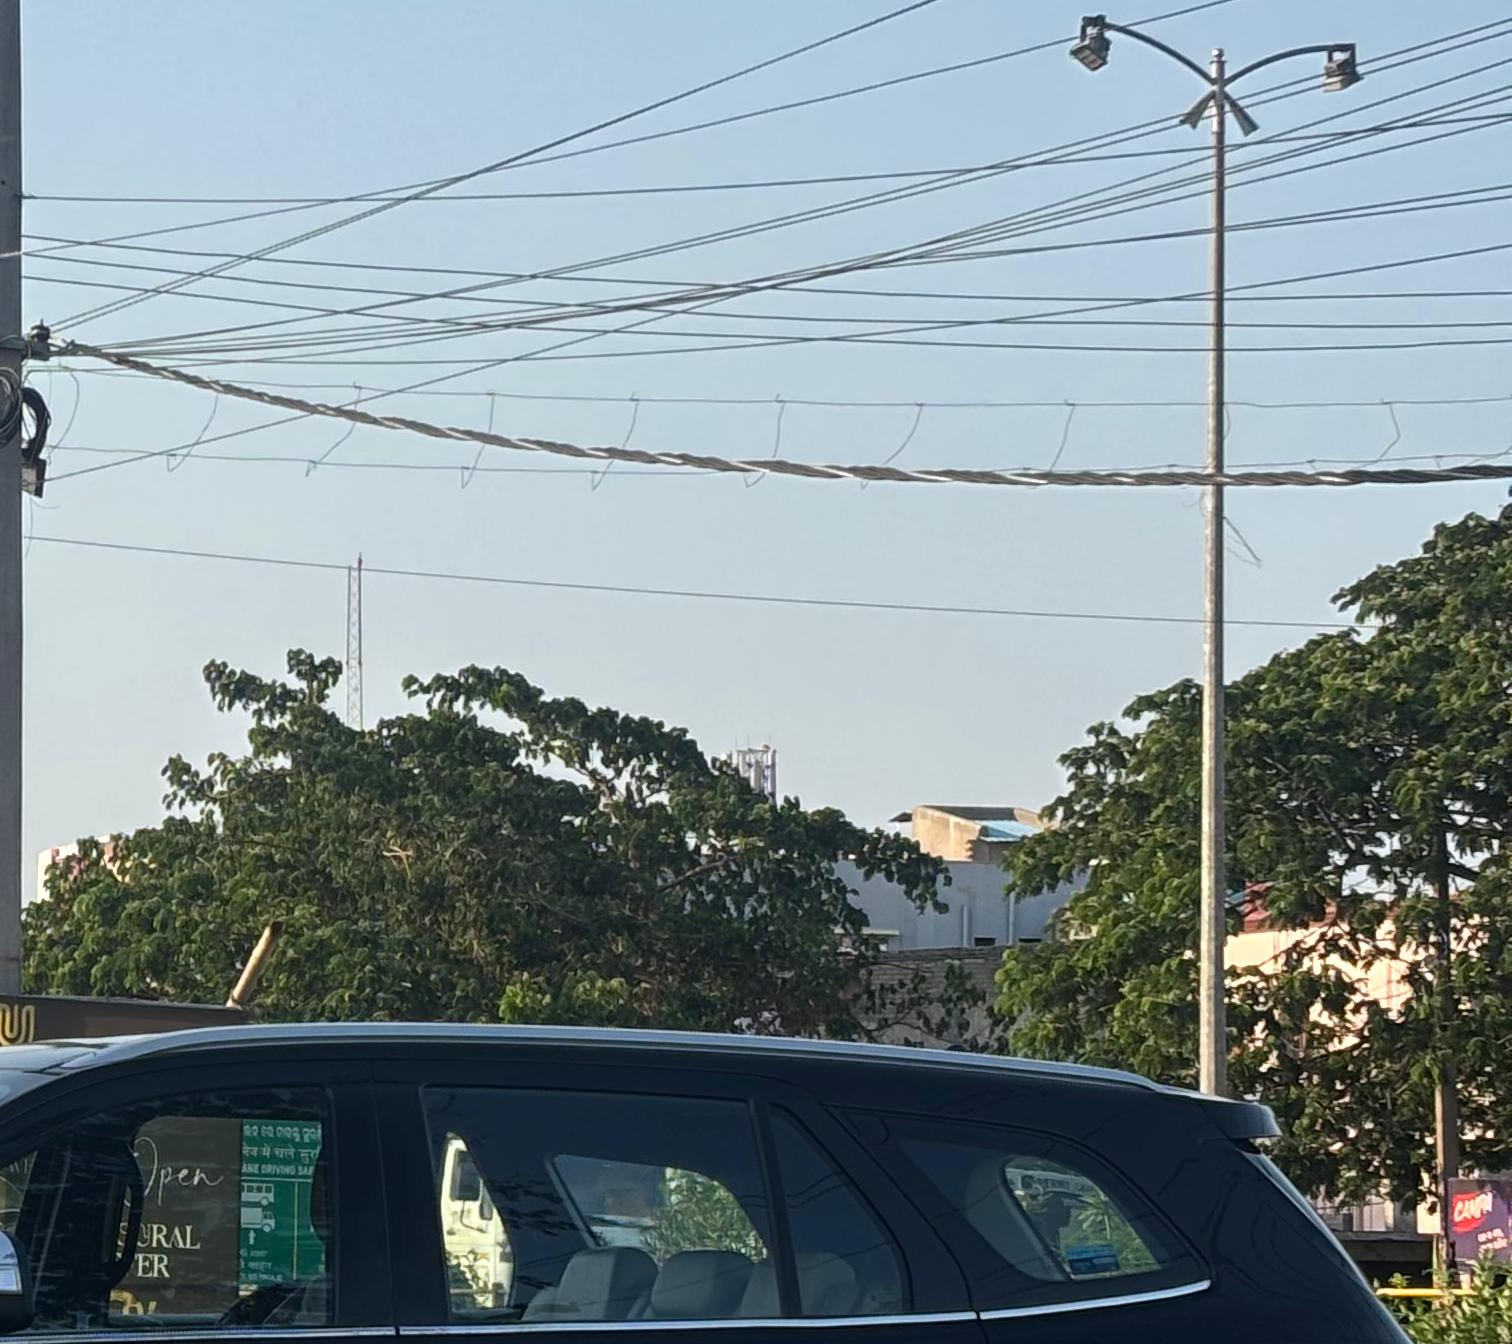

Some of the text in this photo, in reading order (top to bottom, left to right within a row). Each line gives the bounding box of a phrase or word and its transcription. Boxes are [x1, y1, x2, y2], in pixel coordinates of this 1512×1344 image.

[241, 1163, 259, 1174] ANE
[261, 1164, 296, 1176] DRIVING
[135, 1252, 170, 1278] ER
